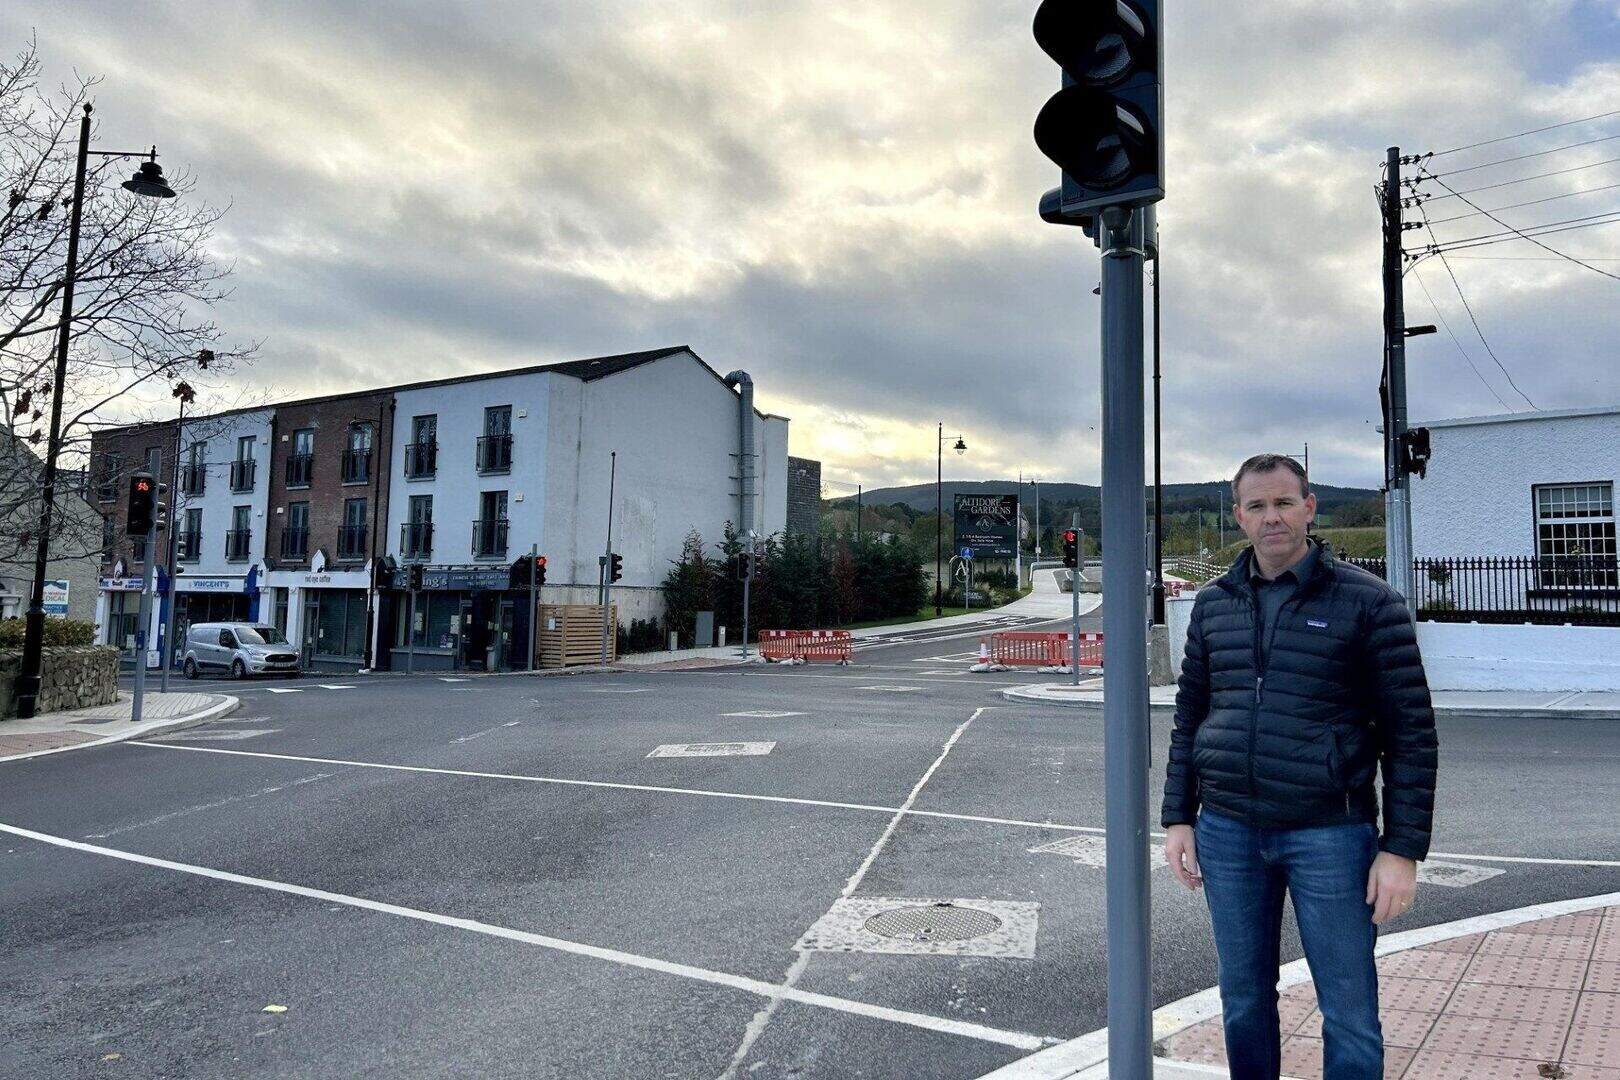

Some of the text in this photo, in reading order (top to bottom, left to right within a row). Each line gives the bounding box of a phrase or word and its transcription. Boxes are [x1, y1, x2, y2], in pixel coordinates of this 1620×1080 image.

[960, 497, 1000, 507] ALTIDORE
[970, 505, 1011, 514] GARDENS
[193, 580, 230, 589] VINCENT'S
